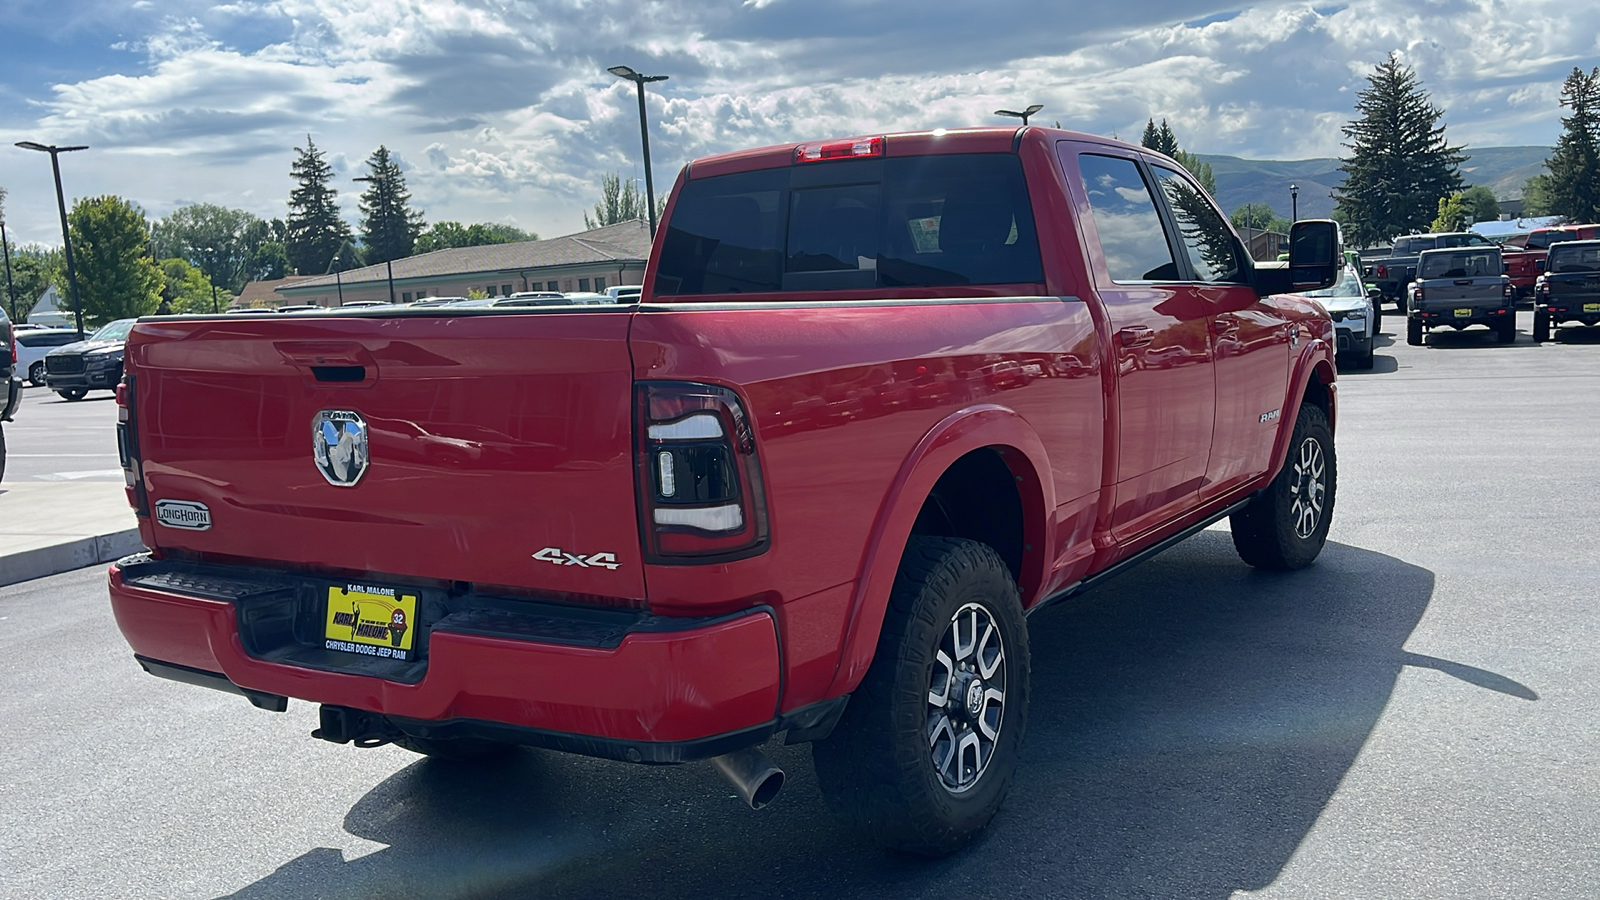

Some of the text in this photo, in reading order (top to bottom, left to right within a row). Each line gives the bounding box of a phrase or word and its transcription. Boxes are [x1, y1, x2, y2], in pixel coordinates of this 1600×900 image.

[321, 411, 359, 422] RAM
[347, 584, 395, 596] KARL MALONE
[393, 613, 404, 624] 32
[332, 611, 353, 626] KARL
[356, 623, 388, 640] MALONE
[325, 640, 407, 660] CHRYSLER DODGE JEEP RAM
